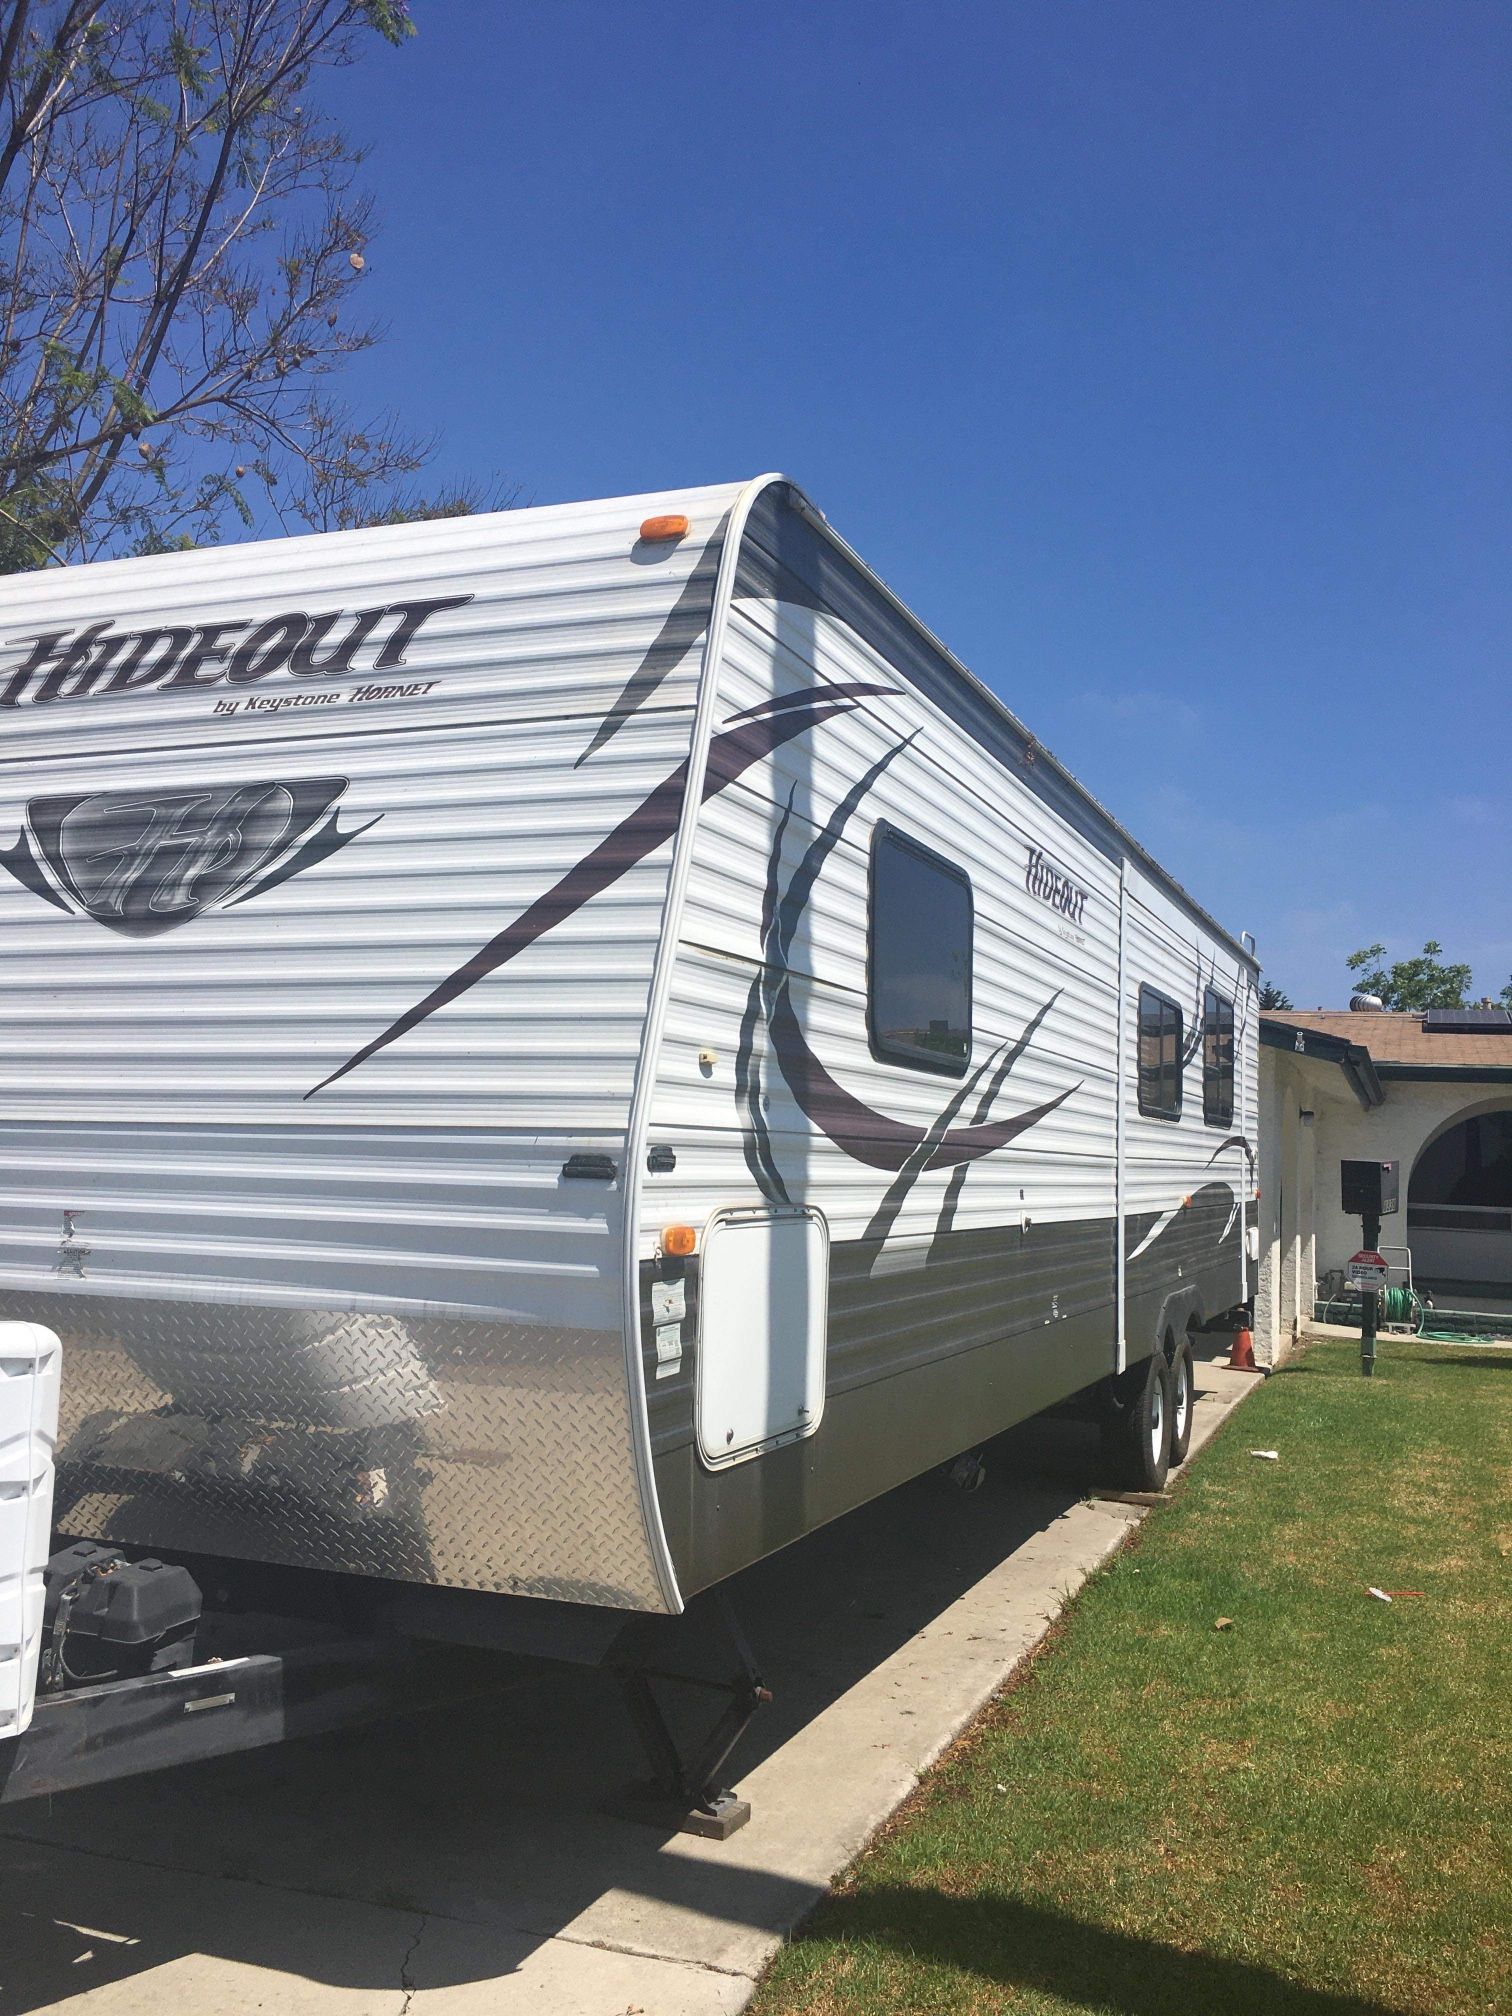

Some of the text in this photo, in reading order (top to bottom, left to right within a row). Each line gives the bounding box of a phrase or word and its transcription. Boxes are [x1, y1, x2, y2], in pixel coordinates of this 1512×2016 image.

[0, 593, 475, 708] HIDEOUT
[213, 680, 442, 716] by Keystone HORNET
[1024, 844, 1088, 925] HIDEOUT
